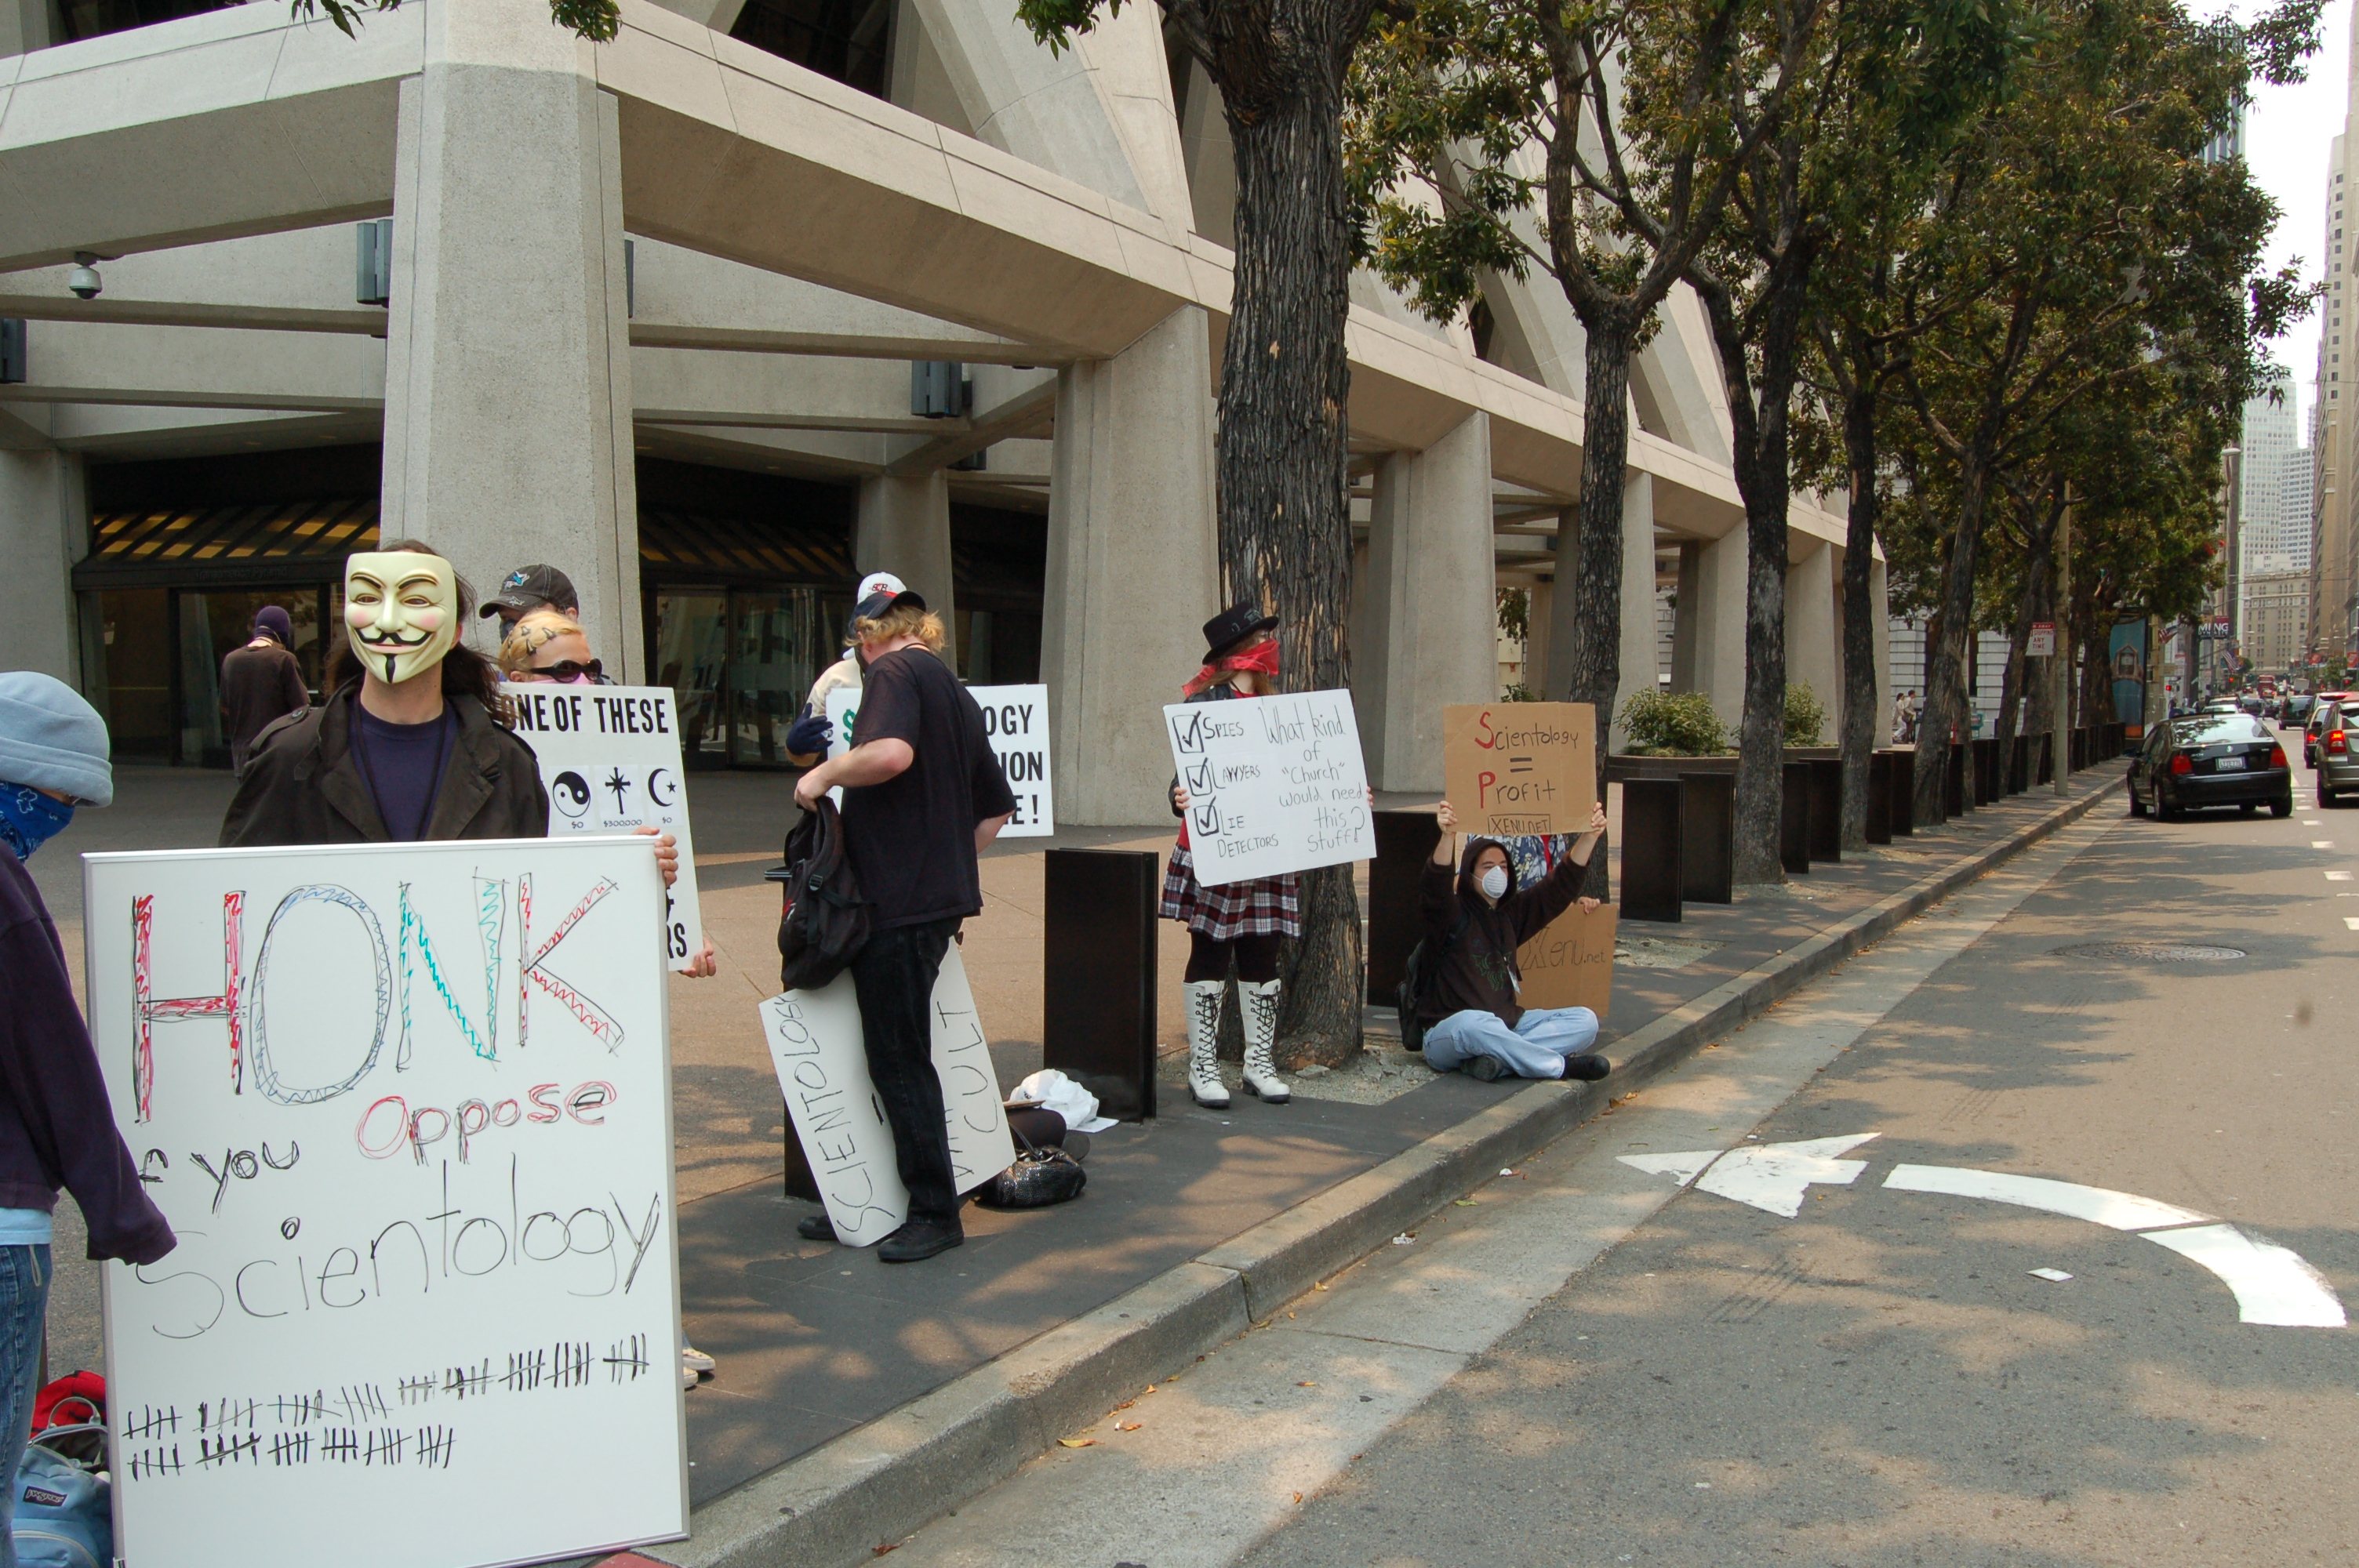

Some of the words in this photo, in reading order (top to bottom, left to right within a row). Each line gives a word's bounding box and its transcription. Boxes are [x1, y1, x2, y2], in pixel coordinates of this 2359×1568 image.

[553, 696, 582, 731] OF
[594, 697, 669, 734] THESE
[1258, 697, 1305, 745] What
[1307, 699, 1347, 738] kind
[1474, 711, 1579, 750] Scientology
[1303, 740, 1321, 761] of
[1279, 786, 1324, 808] would
[1332, 782, 1363, 800] need
[1478, 771, 1556, 809] Profit
[1217, 834, 1278, 858] DETECTORS
[132, 867, 625, 1125] HONK
[936, 1000, 999, 1134] CULT
[773, 994, 896, 1232] SCIENTOLOGY
[190, 1140, 300, 1218] you
[136, 1152, 660, 1339] Scientology
